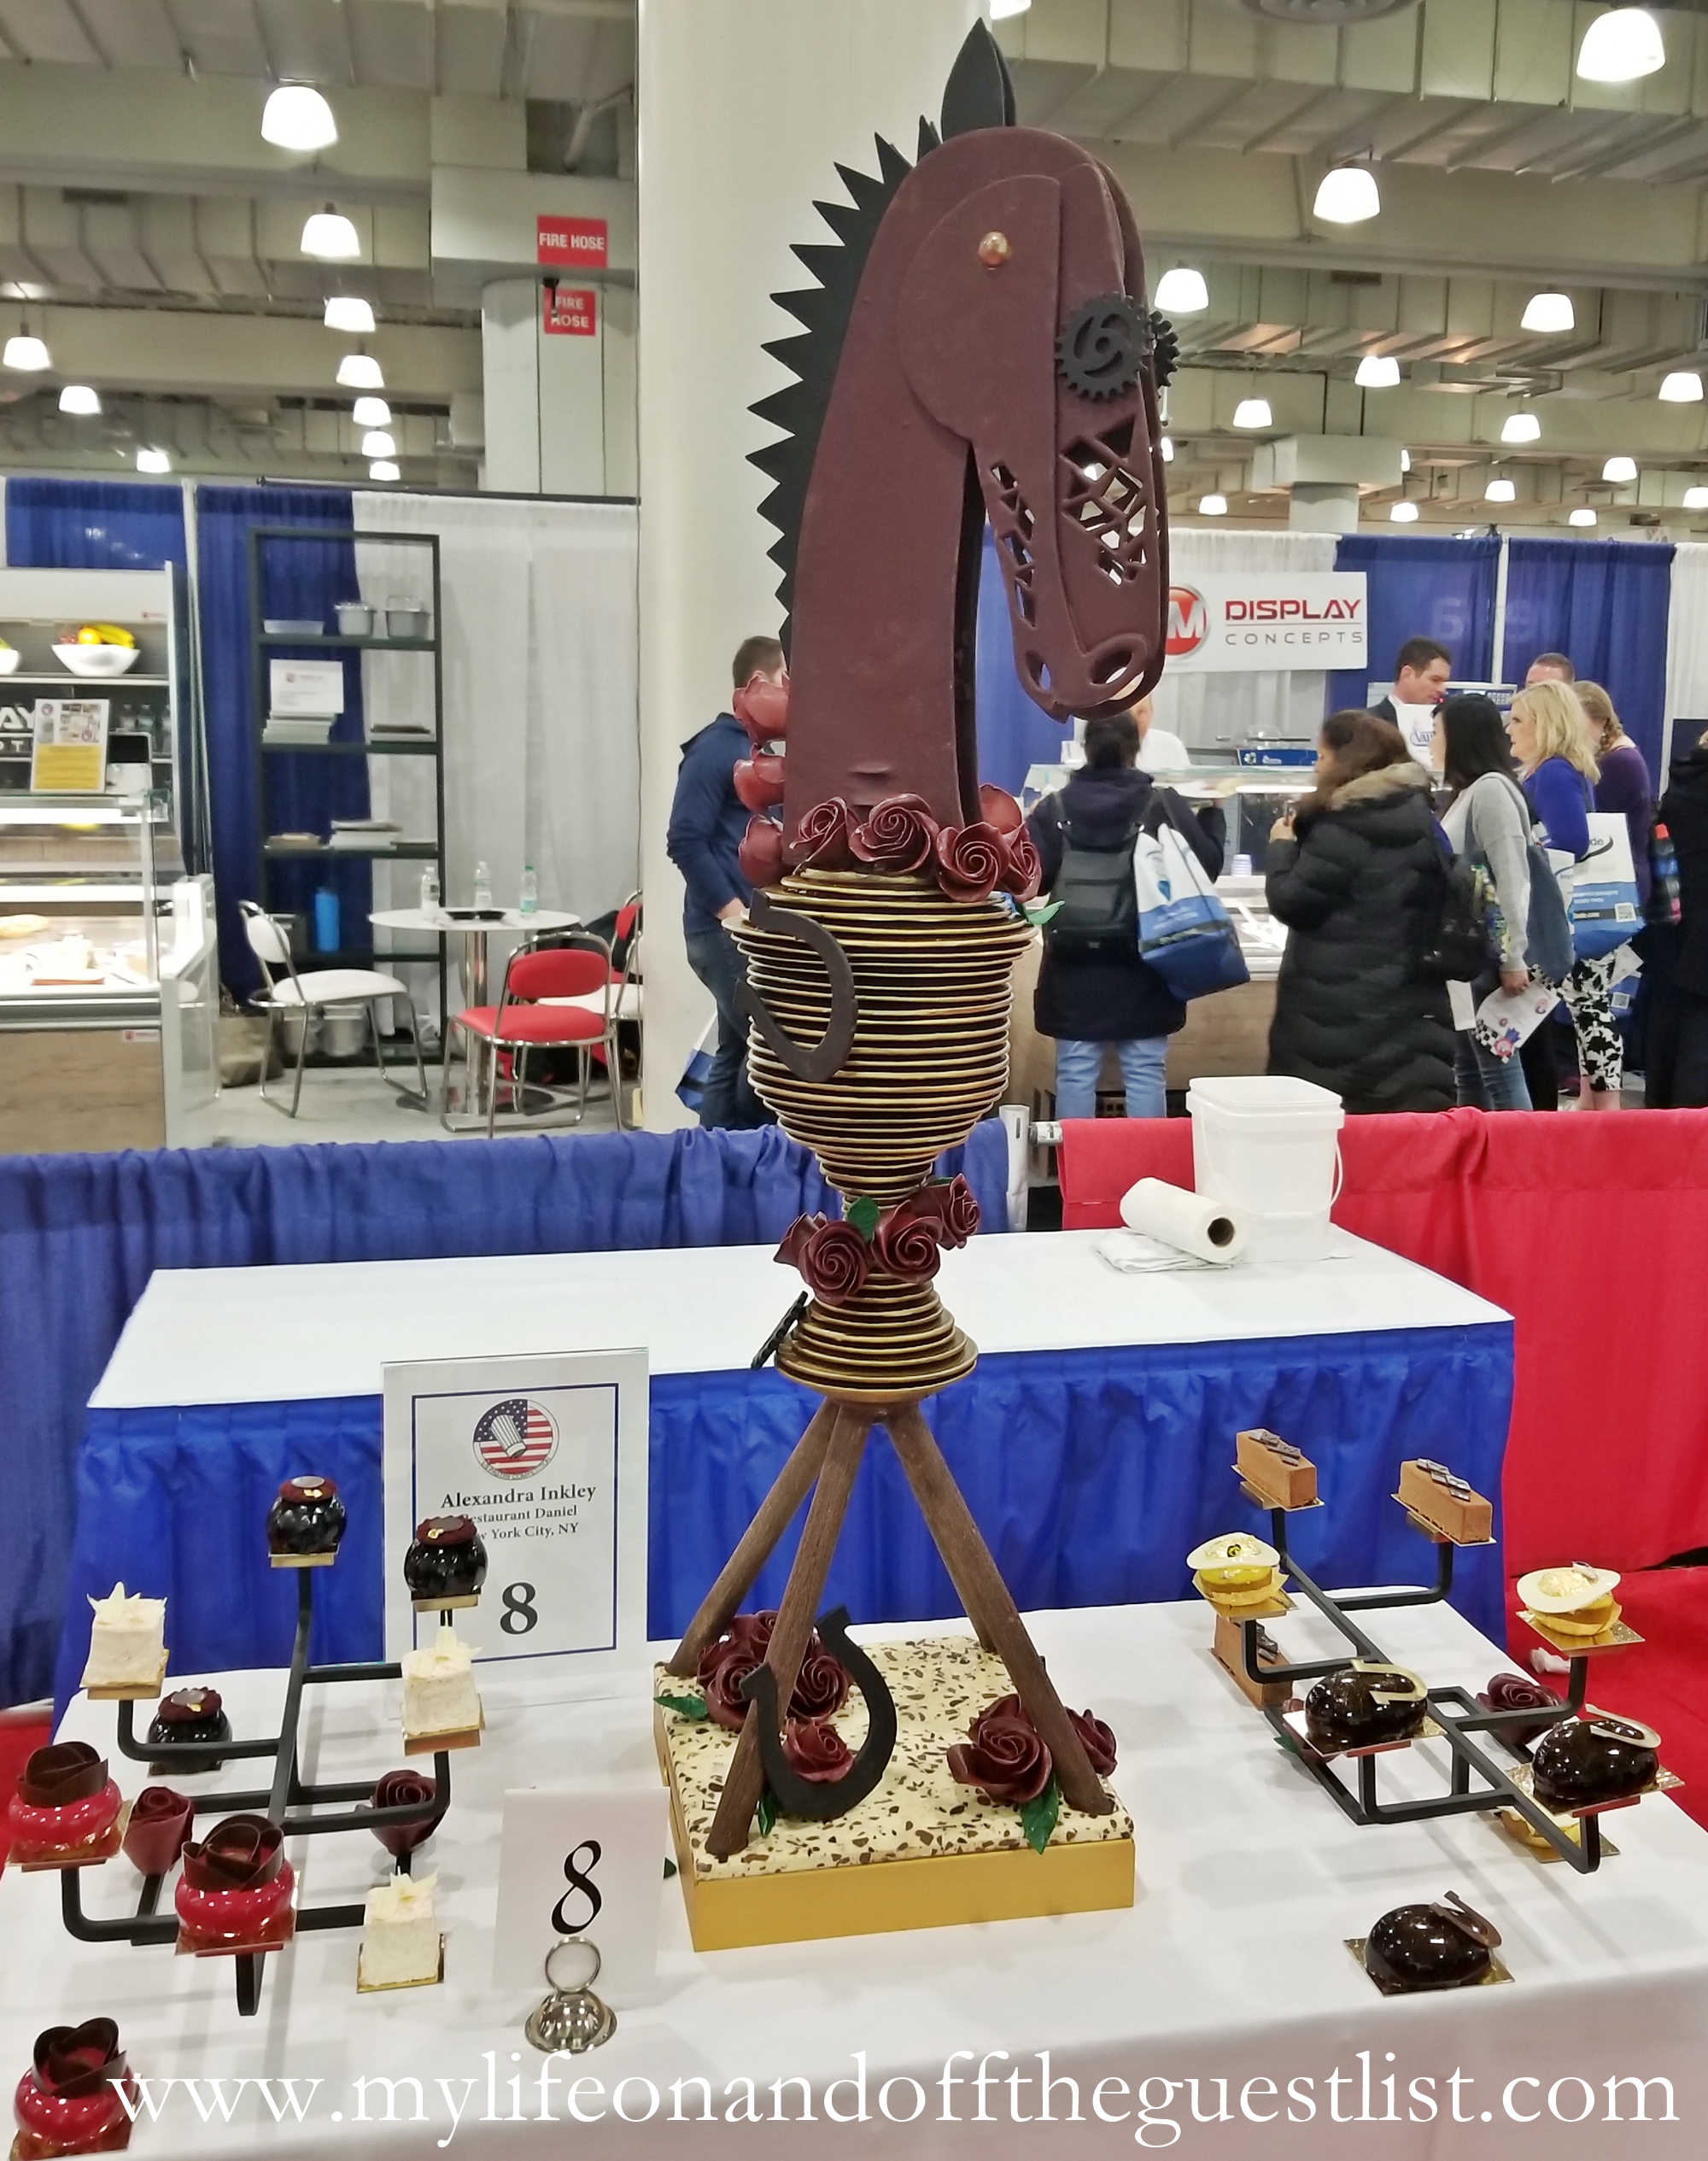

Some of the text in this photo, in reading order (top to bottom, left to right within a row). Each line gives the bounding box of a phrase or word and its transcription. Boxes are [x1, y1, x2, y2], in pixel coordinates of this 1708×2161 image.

[539, 232, 605, 250] FIRE HOSE
[555, 296, 584, 309] FIRE
[1225, 600, 1361, 620] DISPLAY
[1225, 631, 1362, 645] CONCEPTS
[441, 1484, 597, 1508] Alexandra Inkley
[535, 1505, 577, 1519] Daniel
[492, 1527, 521, 1539] York
[524, 1525, 554, 1538] City,
[559, 1522, 579, 1535] NY
[500, 1582, 538, 1635] 8
[552, 1840, 603, 1934] 8
